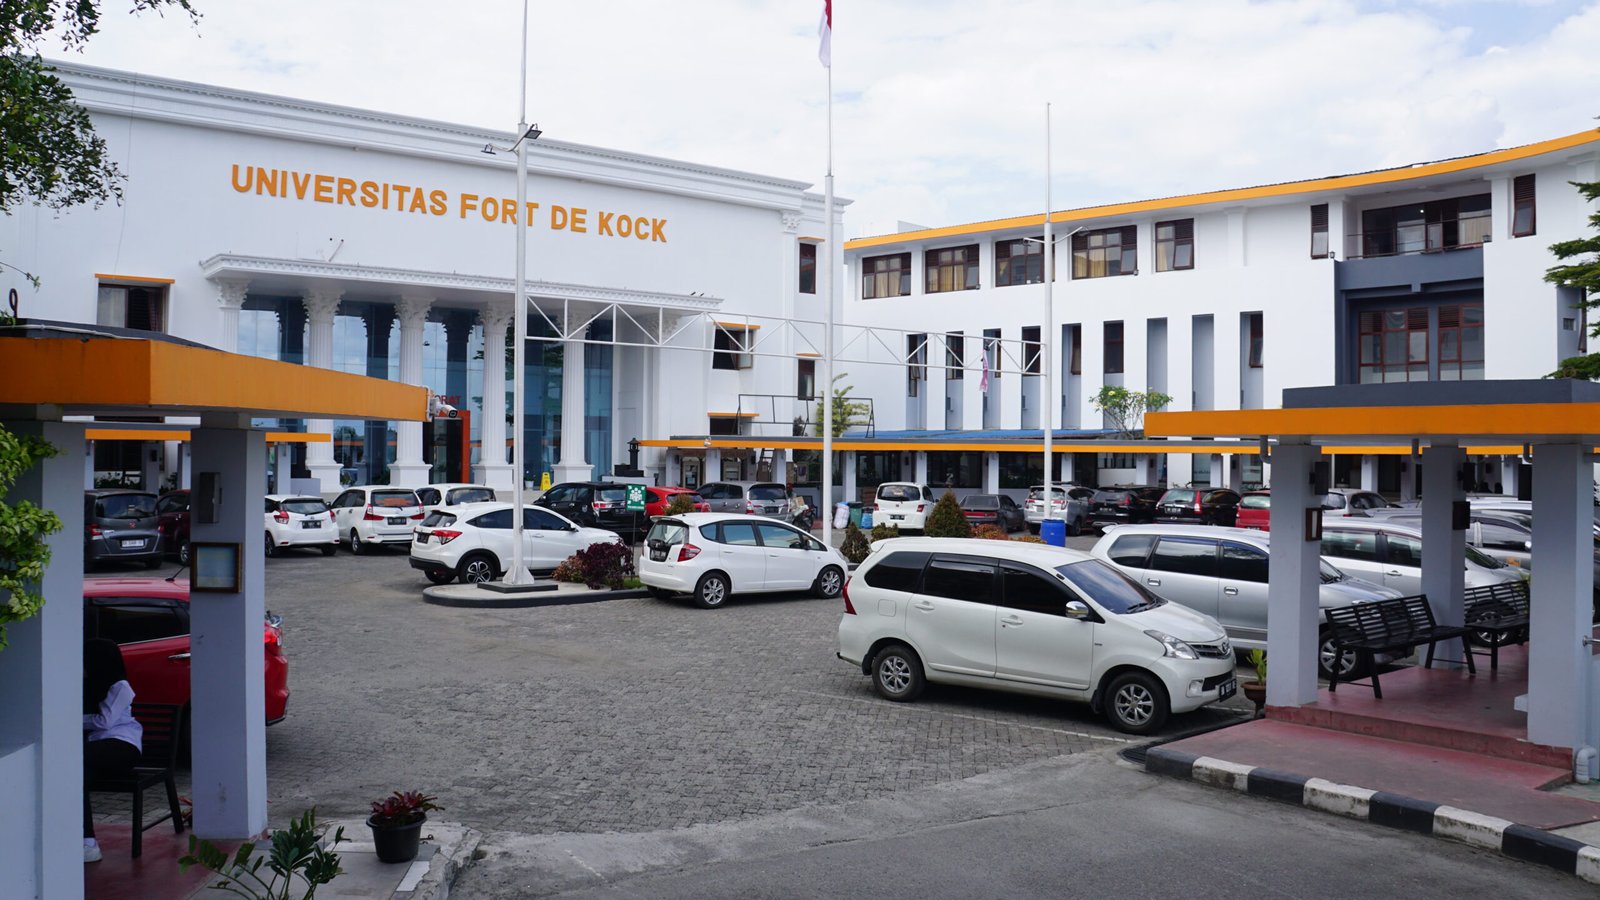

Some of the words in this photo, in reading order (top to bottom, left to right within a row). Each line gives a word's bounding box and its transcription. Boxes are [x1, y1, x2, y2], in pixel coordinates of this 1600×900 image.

[231, 164, 448, 216] UNIVERSITAS
[459, 192, 540, 226] FORT
[550, 205, 588, 233] DE
[598, 211, 667, 242] KOCK
